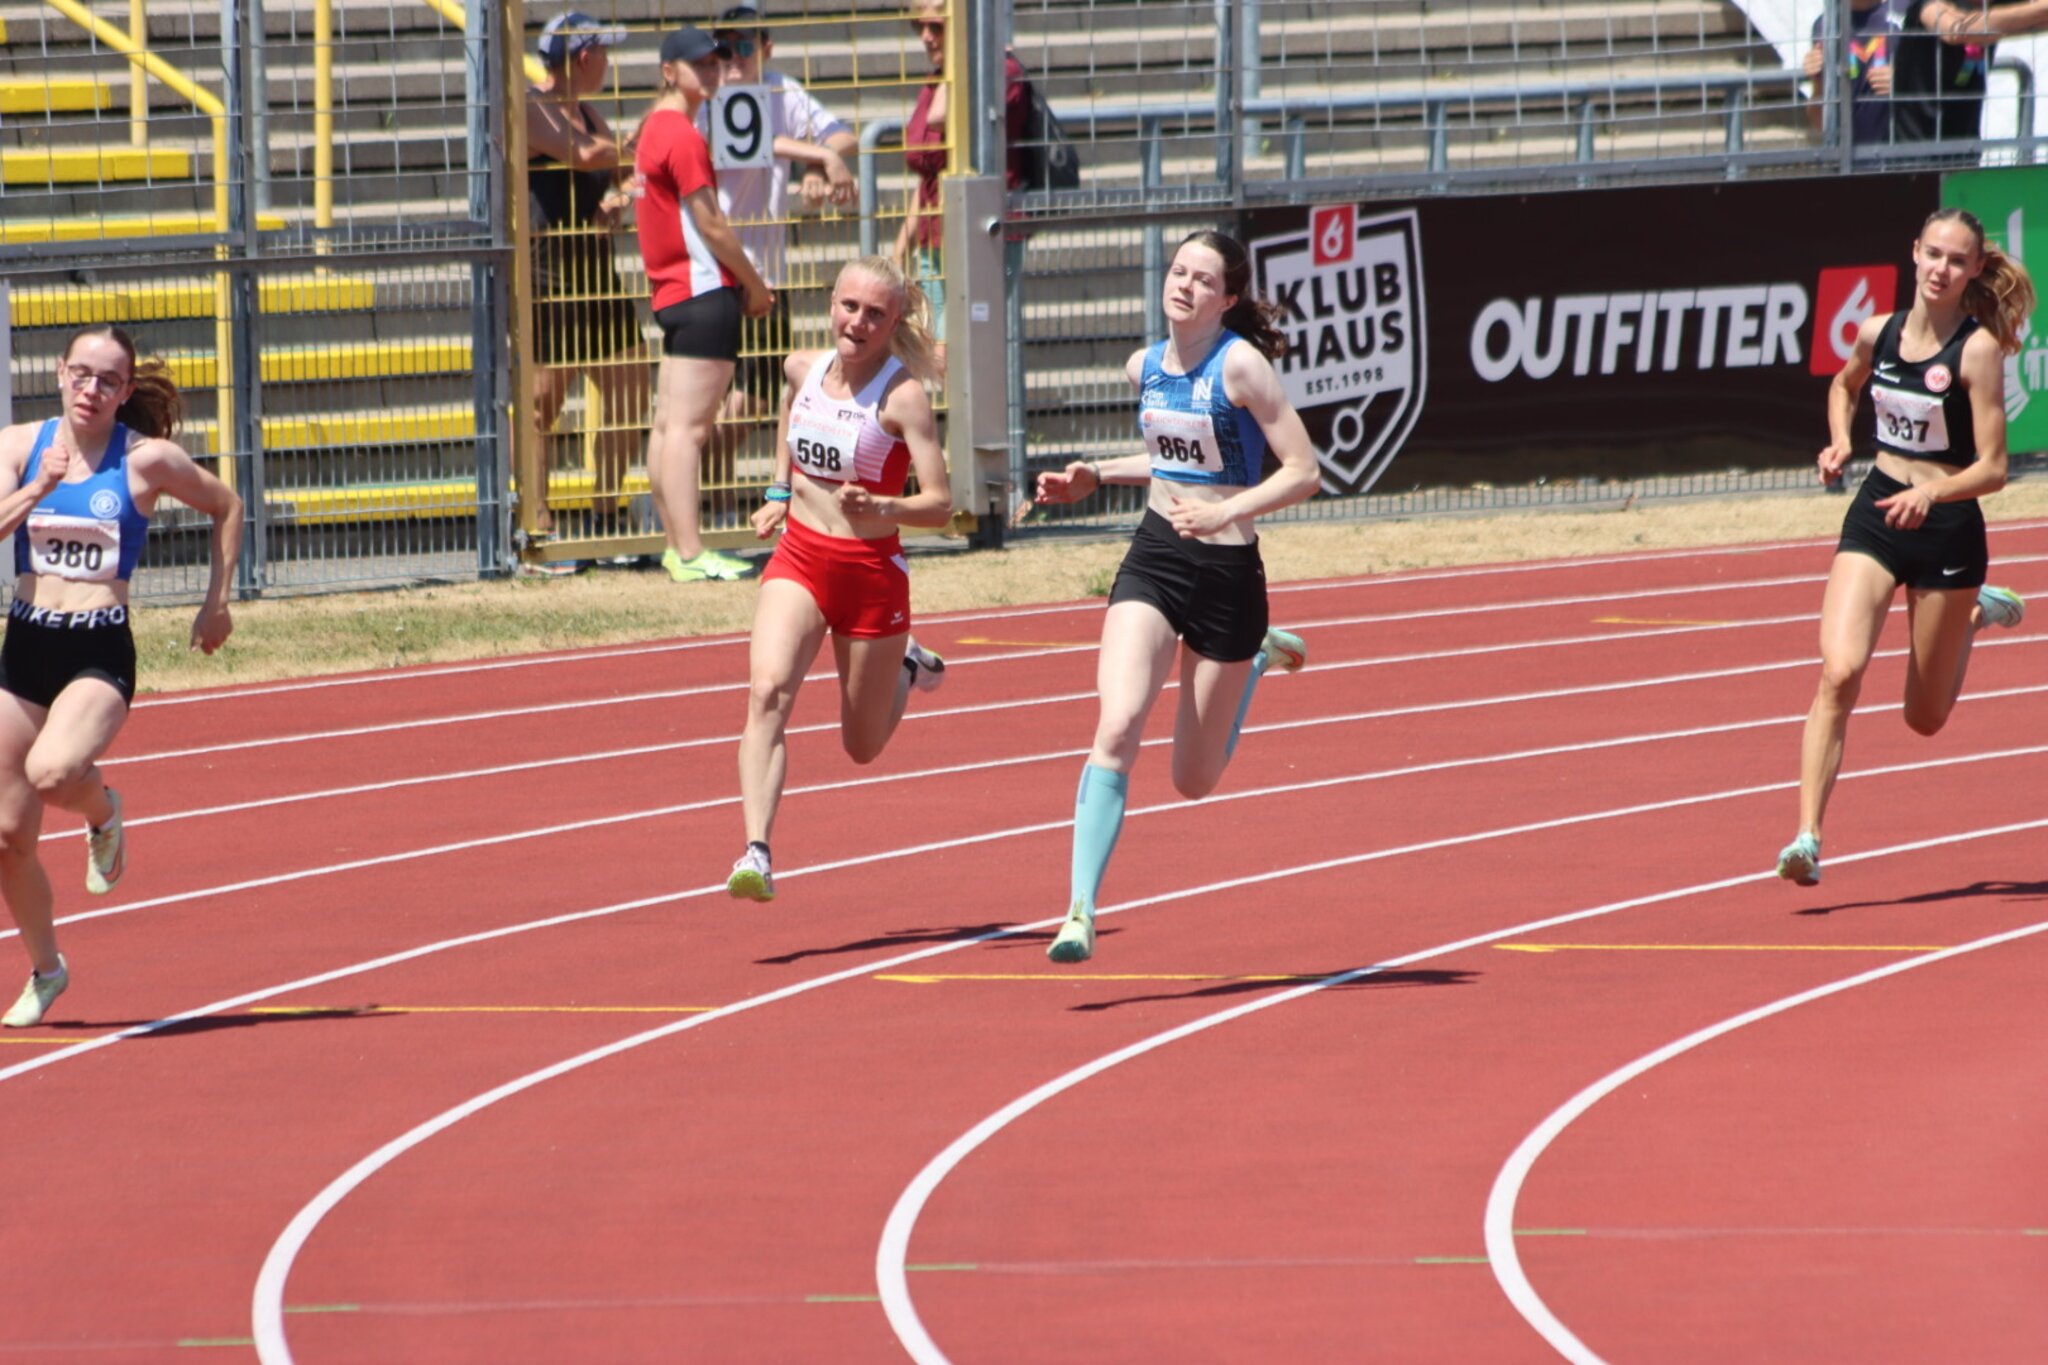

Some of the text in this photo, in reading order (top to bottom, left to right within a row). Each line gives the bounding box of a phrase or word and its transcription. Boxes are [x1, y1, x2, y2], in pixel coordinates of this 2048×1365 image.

[724, 91, 762, 162] 9
[1275, 262, 1401, 326] KLUB
[1282, 311, 1404, 374] HAUS
[1471, 283, 1808, 382] OUTFITTER
[1886, 412, 1930, 443] 337
[797, 437, 841, 472] 598
[1157, 435, 1205, 464] 864
[46, 538, 103, 571] 380
[10, 599, 126, 629] NIKE PRO
